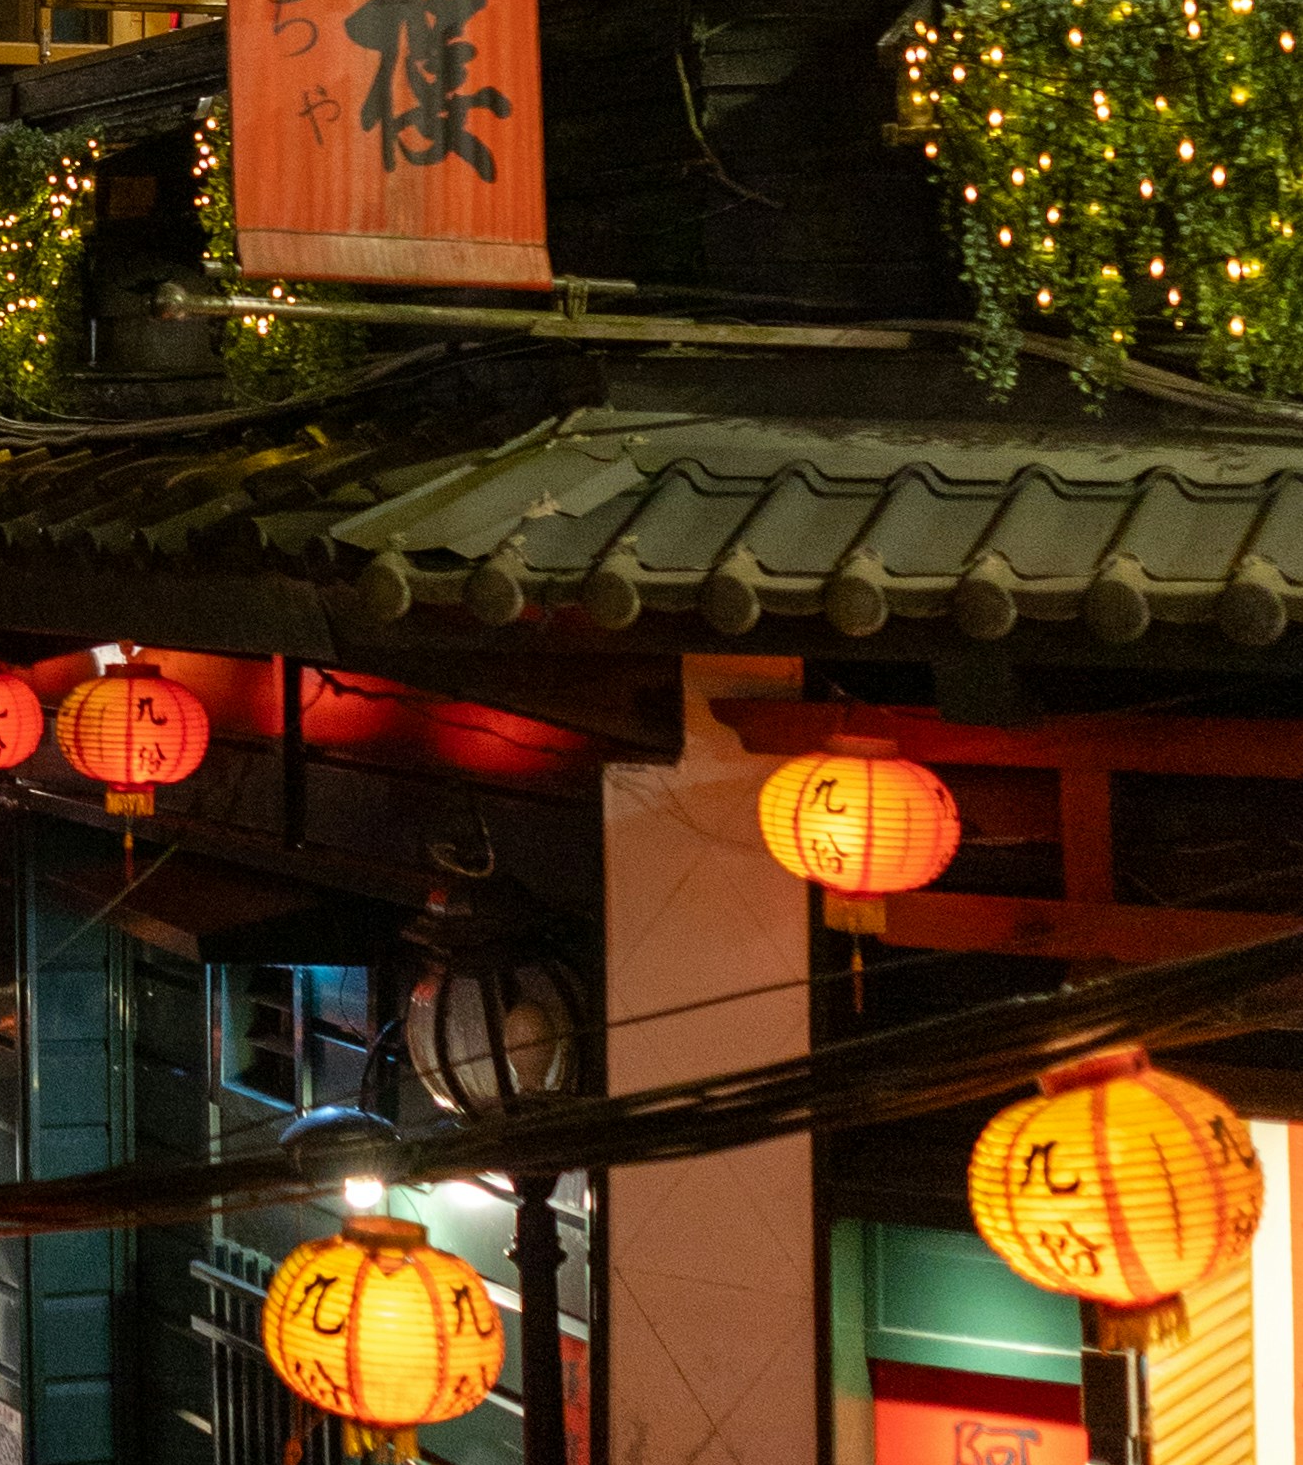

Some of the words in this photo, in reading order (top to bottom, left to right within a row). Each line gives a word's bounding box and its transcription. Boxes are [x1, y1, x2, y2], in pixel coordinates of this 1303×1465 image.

[136, 696, 168, 777] 九份
[806, 777, 850, 875] 九份
[1021, 1140, 1104, 1278] 九份
[292, 1273, 349, 1409] 九份
[451, 1284, 492, 1416] 九份
